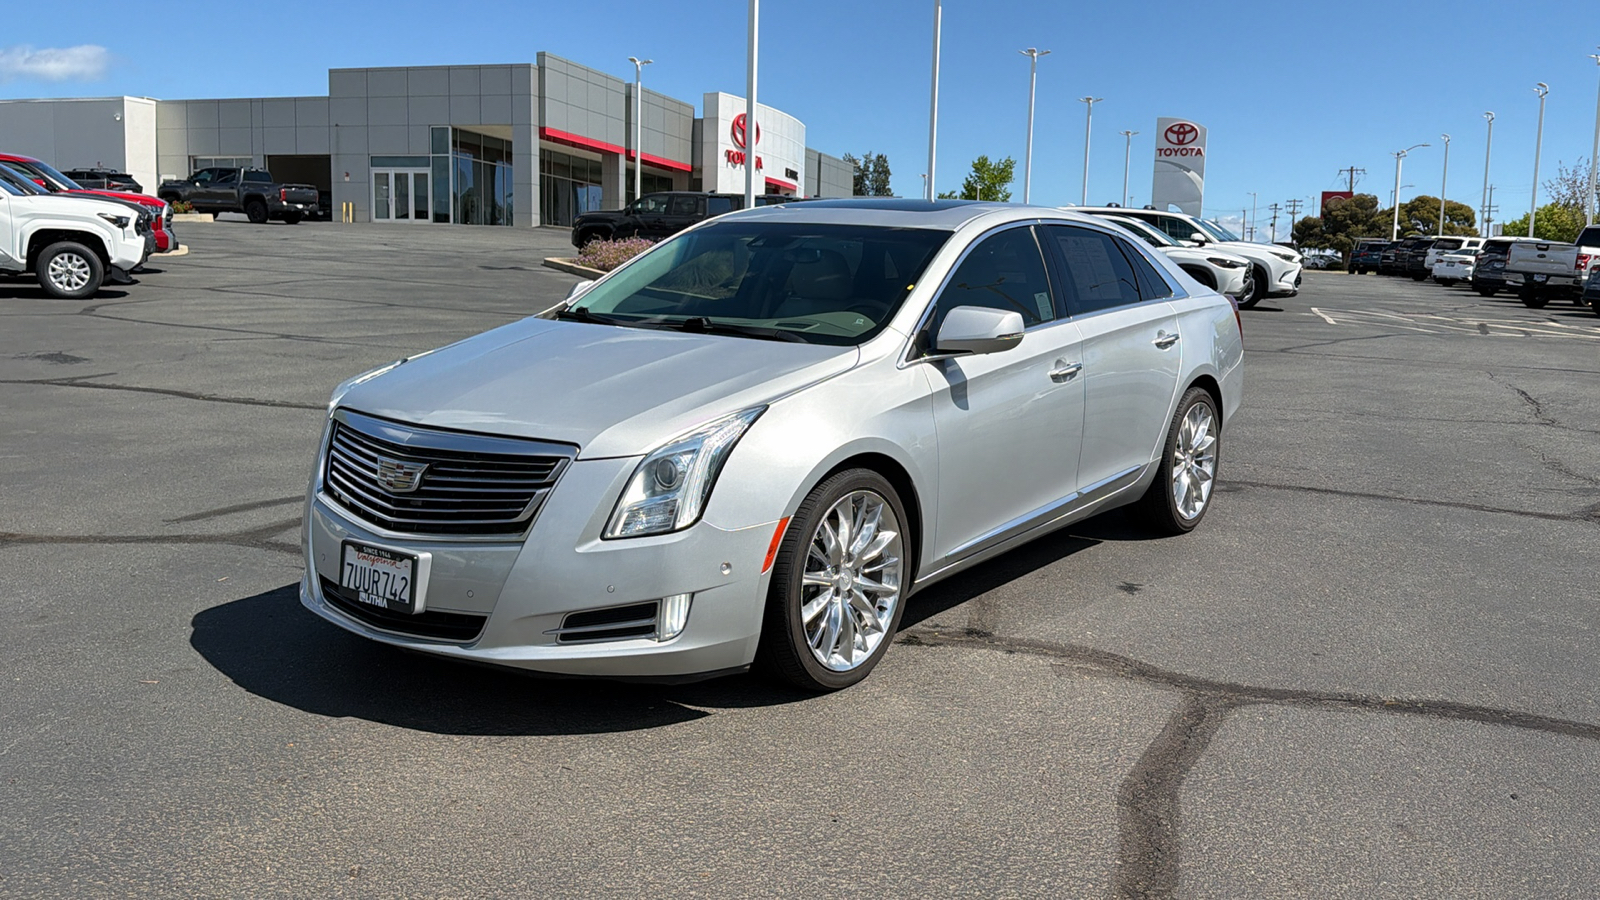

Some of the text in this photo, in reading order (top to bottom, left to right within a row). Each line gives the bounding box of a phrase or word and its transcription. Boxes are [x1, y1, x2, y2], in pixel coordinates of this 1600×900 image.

[725, 149, 763, 170] TOYA
[1157, 147, 1204, 157] TOYOTA
[363, 546, 379, 556] SINCE
[346, 562, 408, 603] 7UUR742
